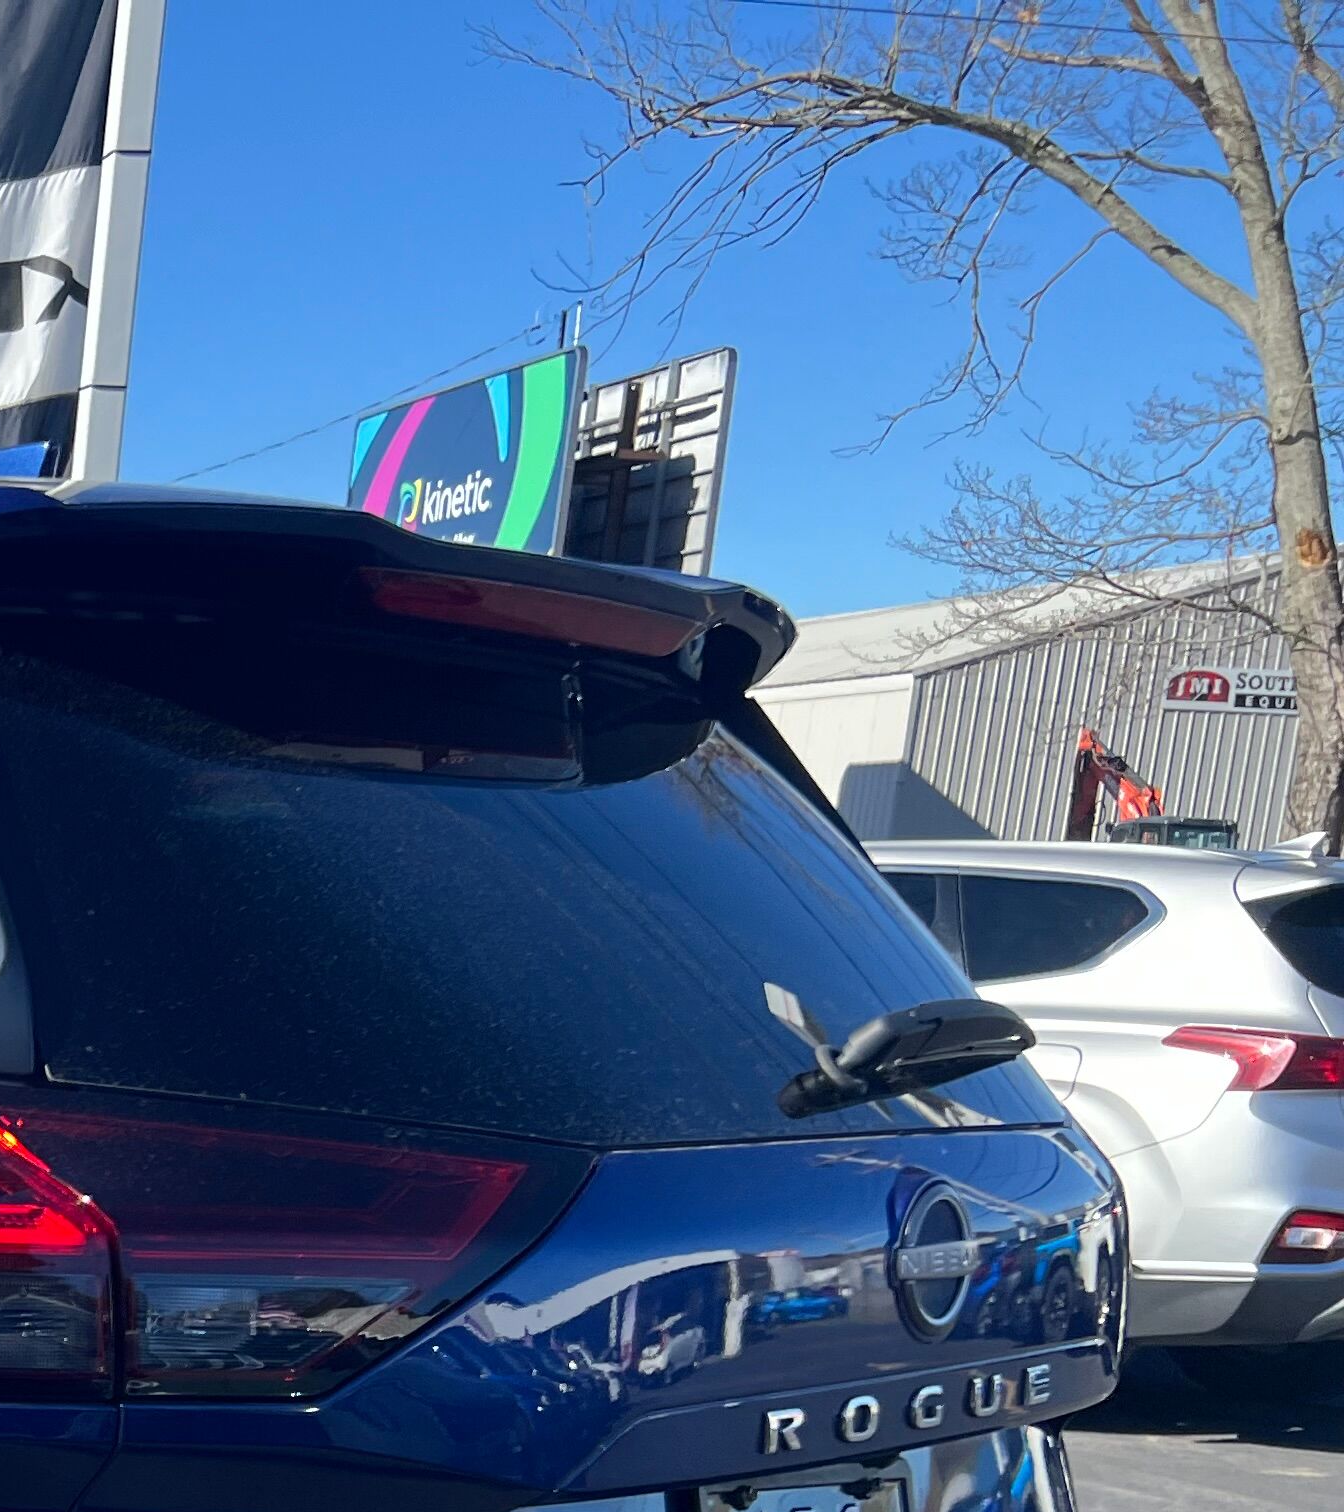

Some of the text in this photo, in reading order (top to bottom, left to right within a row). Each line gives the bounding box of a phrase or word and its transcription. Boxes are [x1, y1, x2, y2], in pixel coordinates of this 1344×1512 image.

[421, 470, 492, 525] kinetic
[1176, 677, 1222, 696] JMI
[763, 1362, 1053, 1455] ROGUE
